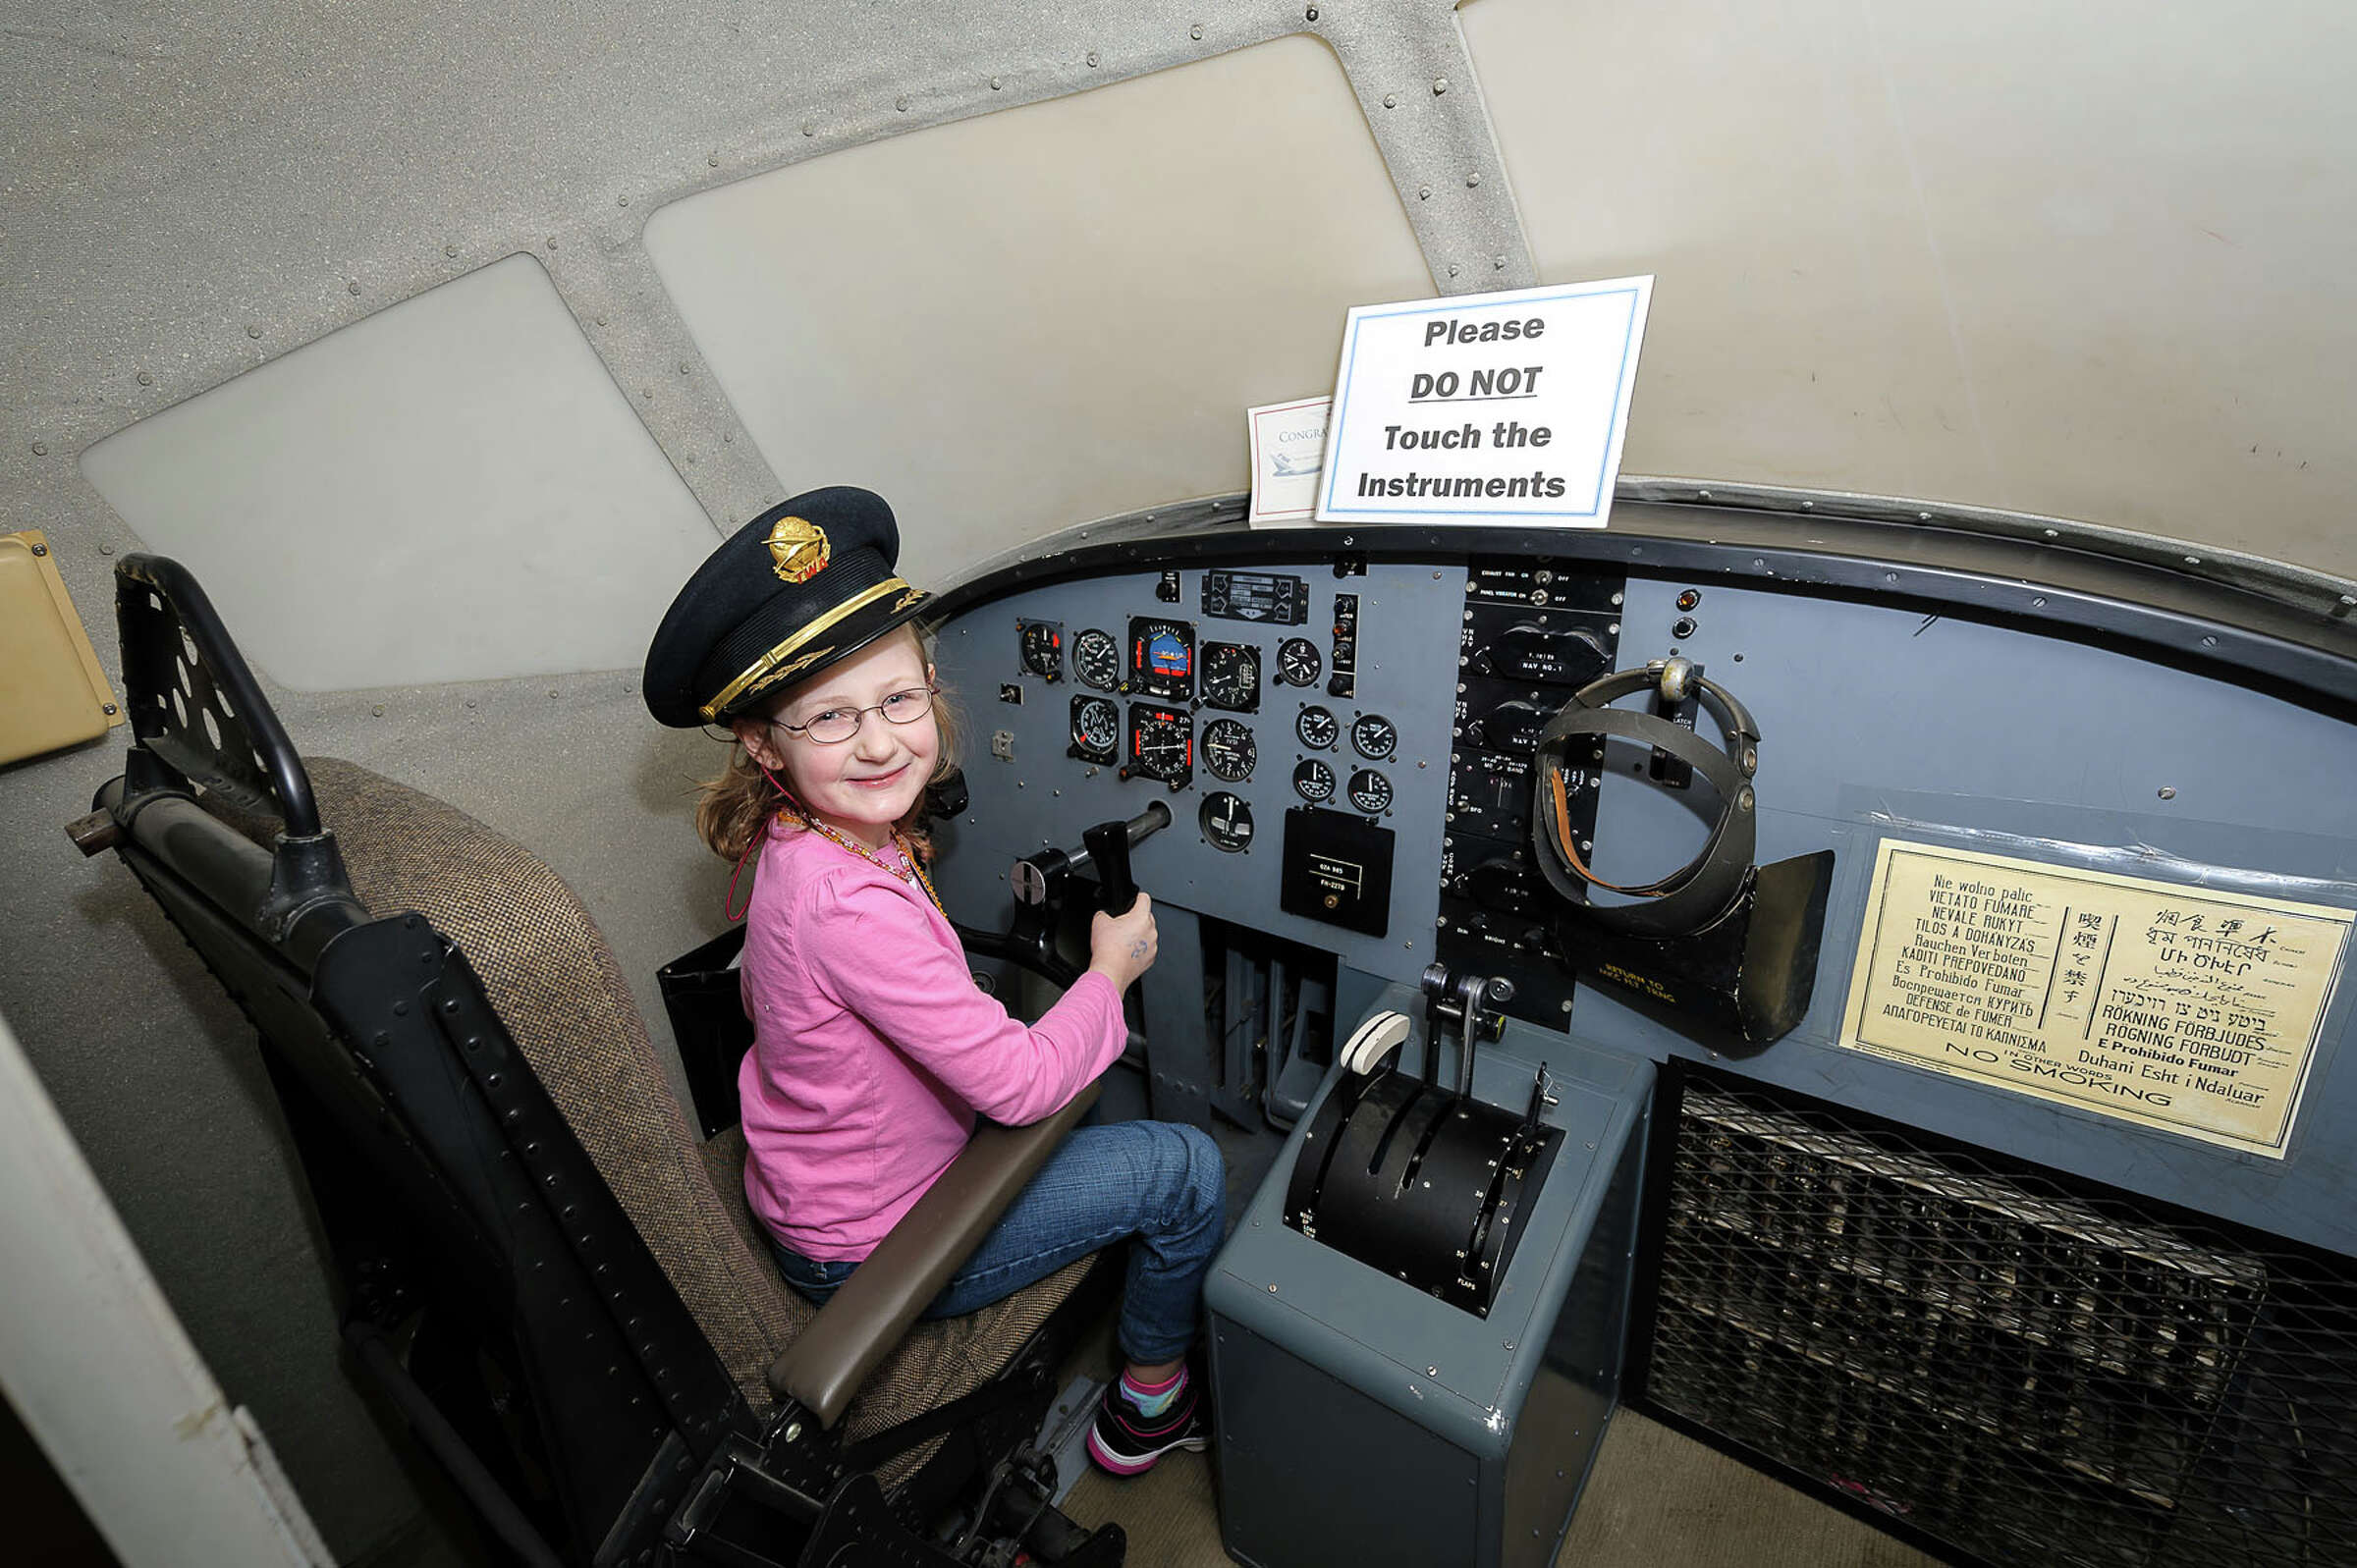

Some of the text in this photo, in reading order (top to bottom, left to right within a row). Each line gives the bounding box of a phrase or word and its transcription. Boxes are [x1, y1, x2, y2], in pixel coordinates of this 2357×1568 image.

[1424, 317, 1545, 347] Please
[1410, 366, 1543, 399] DO NOT
[1384, 421, 1552, 450] Touch the
[1357, 471, 1565, 498] Instruments
[796, 557, 828, 584] TWA
[1934, 874, 1952, 889] Nie
[1959, 882, 1995, 896] wolno
[1930, 890, 2035, 919] VIETATO FUMARE
[1915, 918, 1947, 936] TILOS
[1952, 926, 1959, 939] A
[1933, 906, 2024, 933] NEVALE RUKYT
[1915, 934, 1966, 955] Rauchen
[1901, 946, 2026, 982] KADITI PREPOVEDANO
[1896, 960, 2025, 999] Es Prohibido Fumar
[1905, 993, 2012, 1028] DEFENSE de FUMER
[2003, 1049, 2112, 1080] IN OTHER WORDS
[2098, 1038, 2109, 1049] E
[2111, 1041, 2185, 1066] Prohibido
[2188, 1058, 2239, 1078] Fumar
[2179, 1038, 2257, 1066] FORBUDT
[1946, 1043, 1999, 1063] NO
[2009, 1058, 2172, 1107] SMOKING
[2078, 1050, 2134, 1074] Duhani
[2141, 1064, 2179, 1085] Esht
[2185, 1074, 2191, 1087] i
[2195, 1077, 2265, 1104] Ndaluar
[1457, 1277, 1476, 1290] FLAPS
